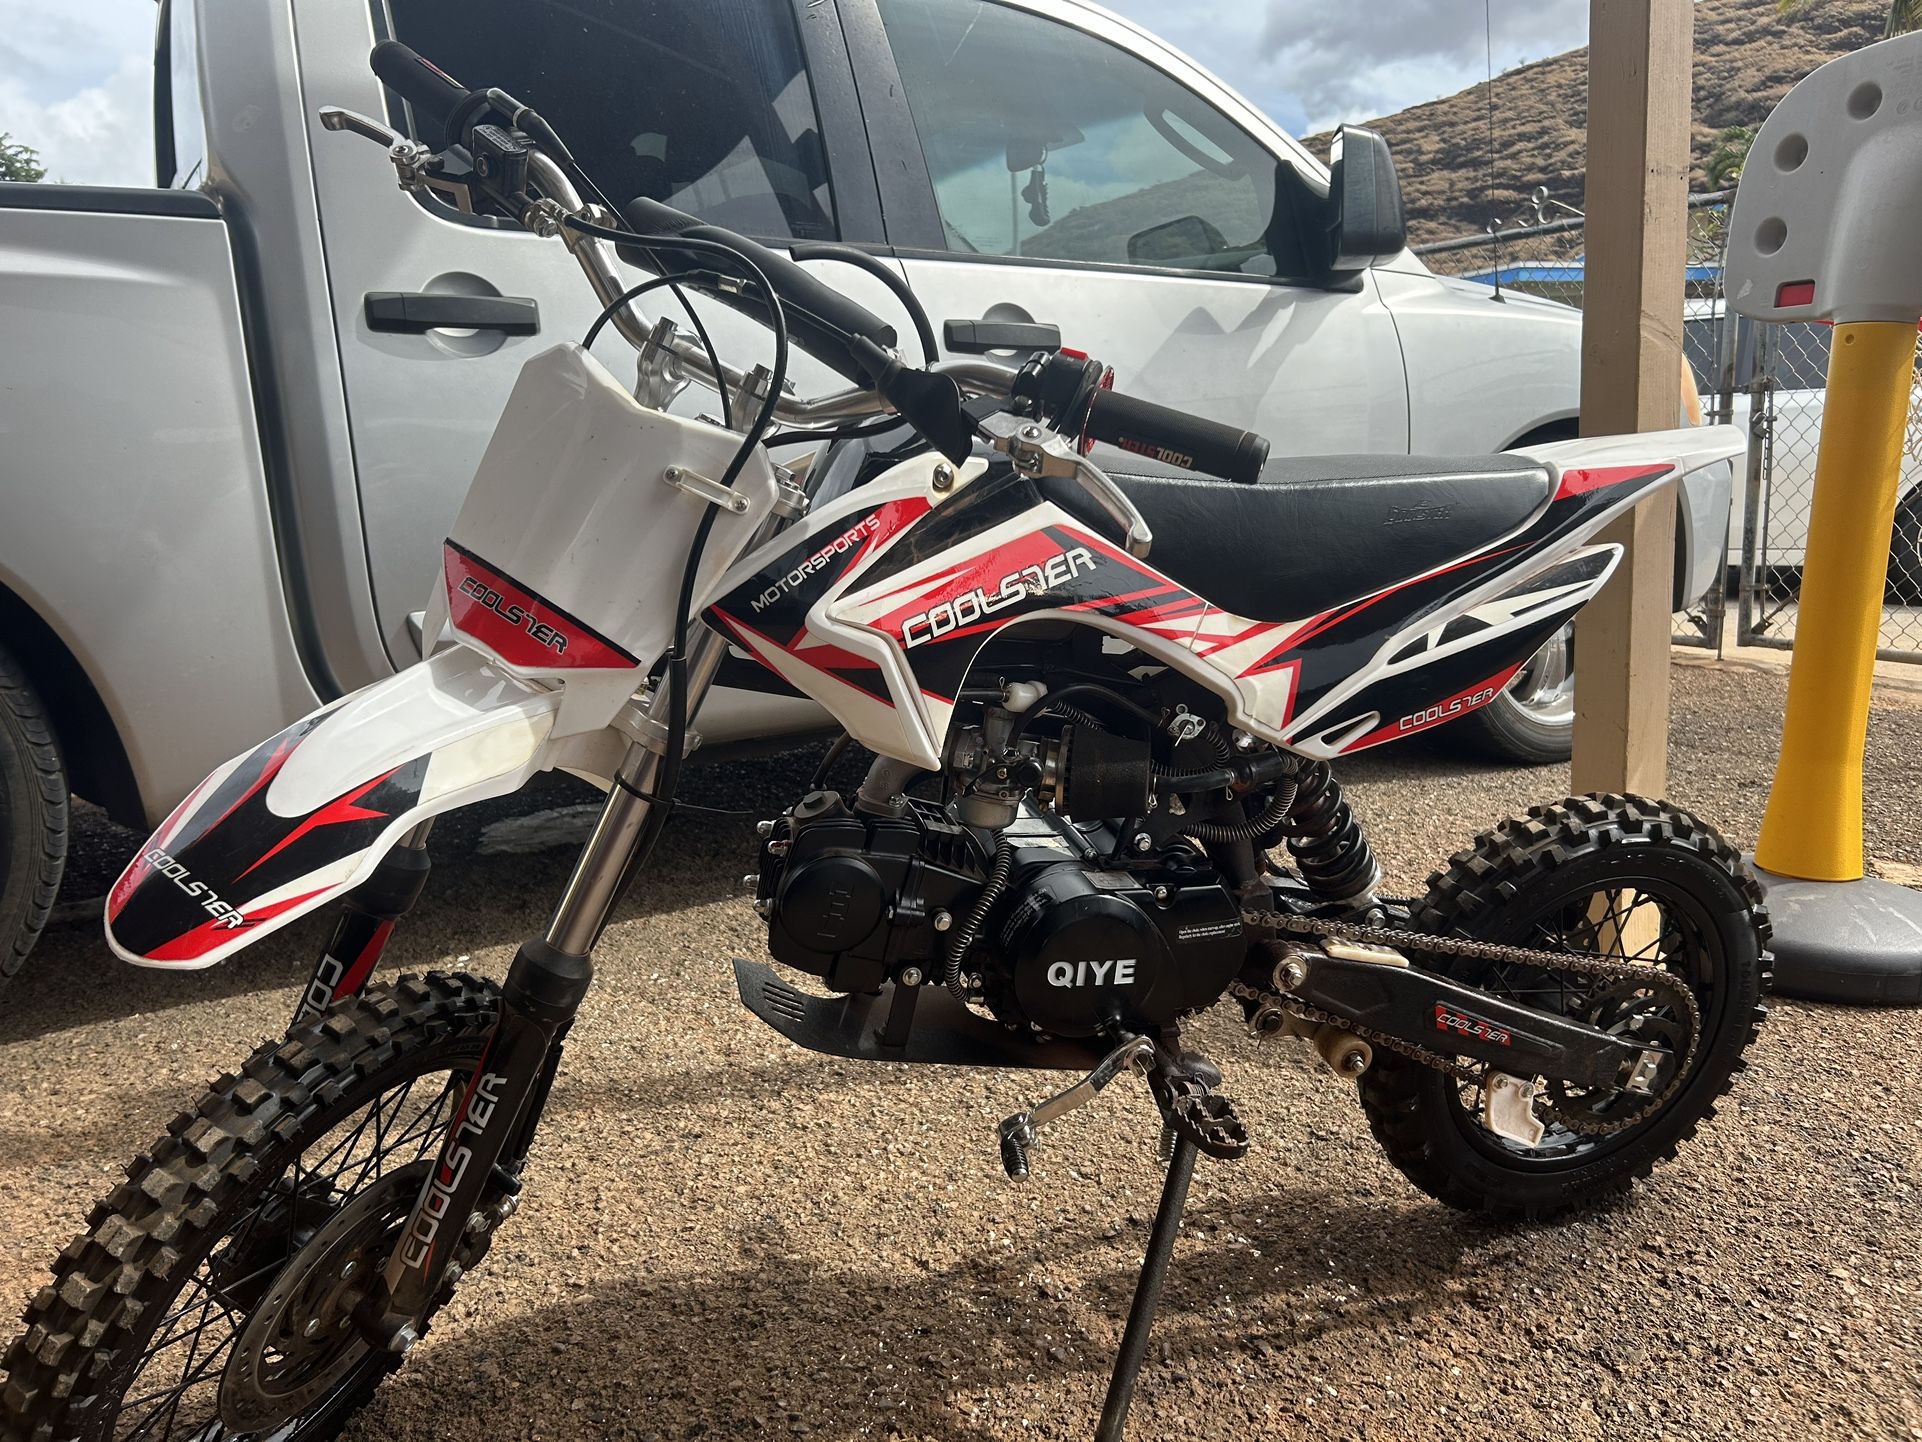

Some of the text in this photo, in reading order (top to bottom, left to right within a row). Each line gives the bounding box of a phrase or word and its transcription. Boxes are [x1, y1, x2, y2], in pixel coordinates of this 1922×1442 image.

[751, 514, 880, 613] MOTORSPORTS
[902, 547, 1096, 649] COOLSTER
[459, 576, 568, 655] COOLSTER
[1400, 687, 1494, 731] COOLSTER
[144, 848, 244, 929] COOLSTER
[1047, 959, 1136, 989] QIYE
[1437, 1013, 1508, 1043] COOLSTER
[400, 1073, 507, 1269] COOLSTER
